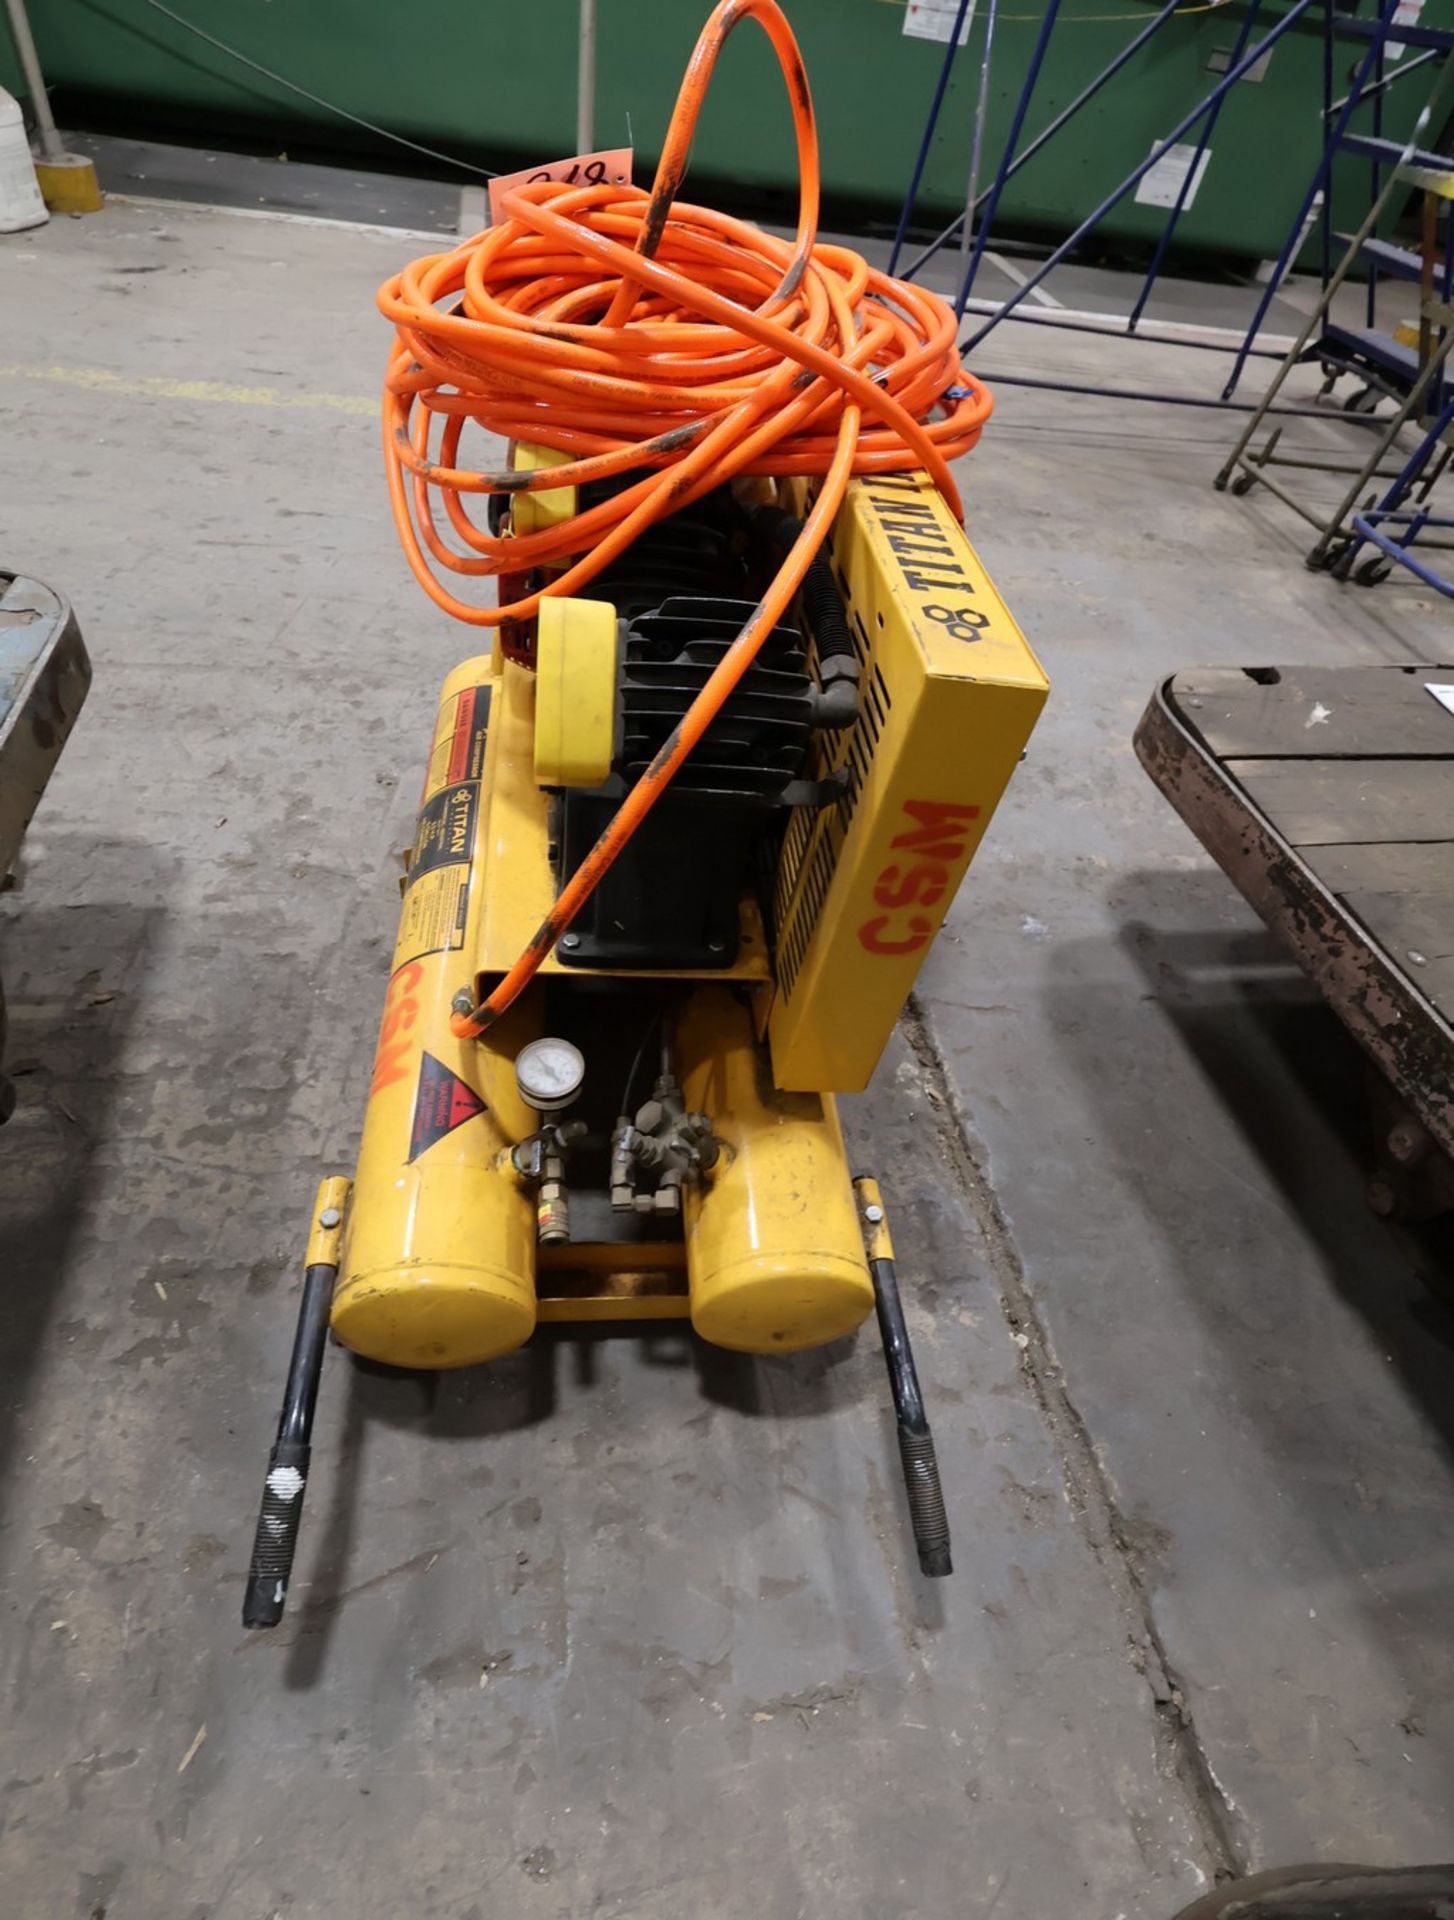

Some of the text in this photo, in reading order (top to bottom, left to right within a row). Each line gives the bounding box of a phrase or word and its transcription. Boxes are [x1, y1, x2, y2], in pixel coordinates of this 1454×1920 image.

[867, 495, 975, 594] TITAN
[471, 741, 482, 778] COMPRESSOR
[450, 803, 468, 853] TITAN
[858, 799, 982, 956] CSM
[434, 1079, 449, 1128] WARNING
